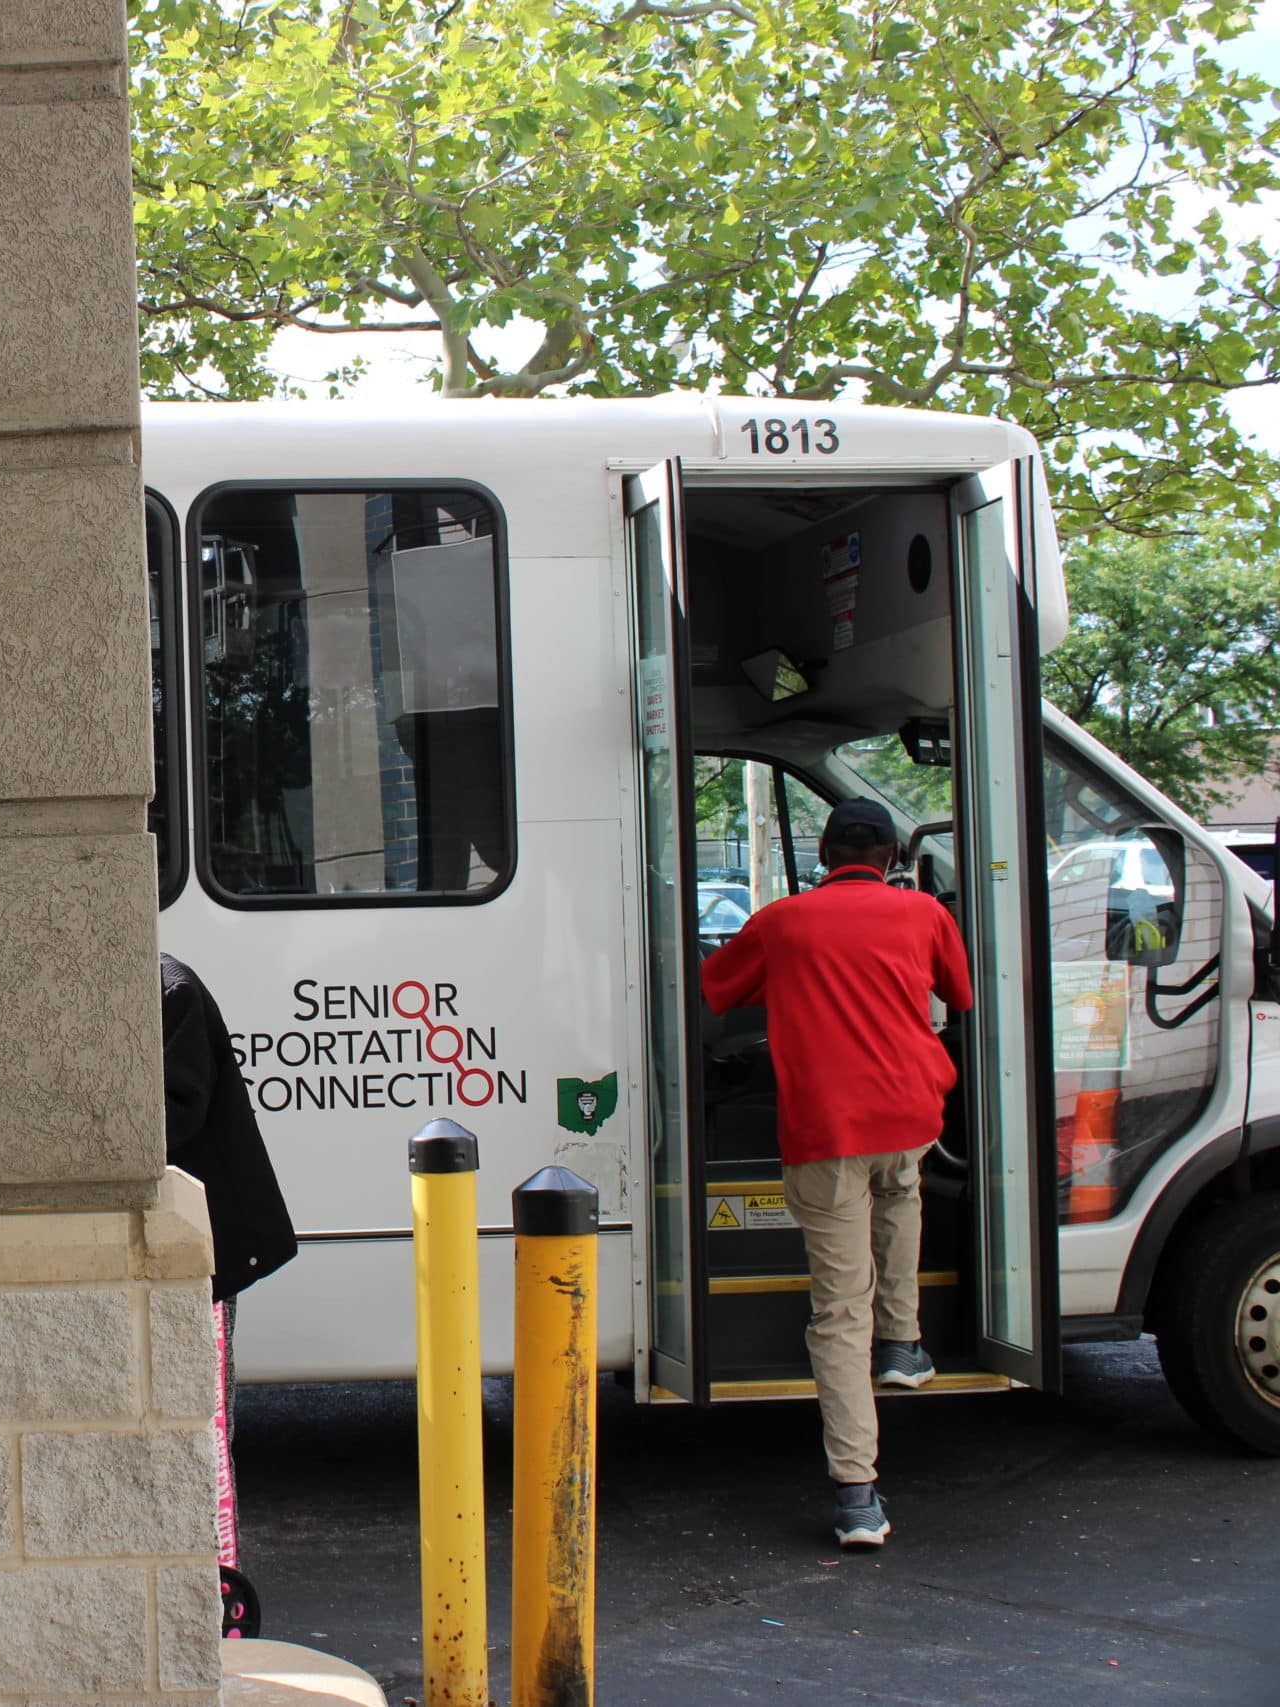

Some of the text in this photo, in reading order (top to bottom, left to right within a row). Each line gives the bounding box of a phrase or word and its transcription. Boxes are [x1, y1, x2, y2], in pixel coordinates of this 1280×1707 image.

[741, 418, 840, 455] 1813
[293, 979, 459, 1021] SENIOR
[229, 1025, 496, 1068] SPORTATION
[242, 1069, 527, 1112] ONNECTION
[759, 1197, 784, 1206] CAUT
